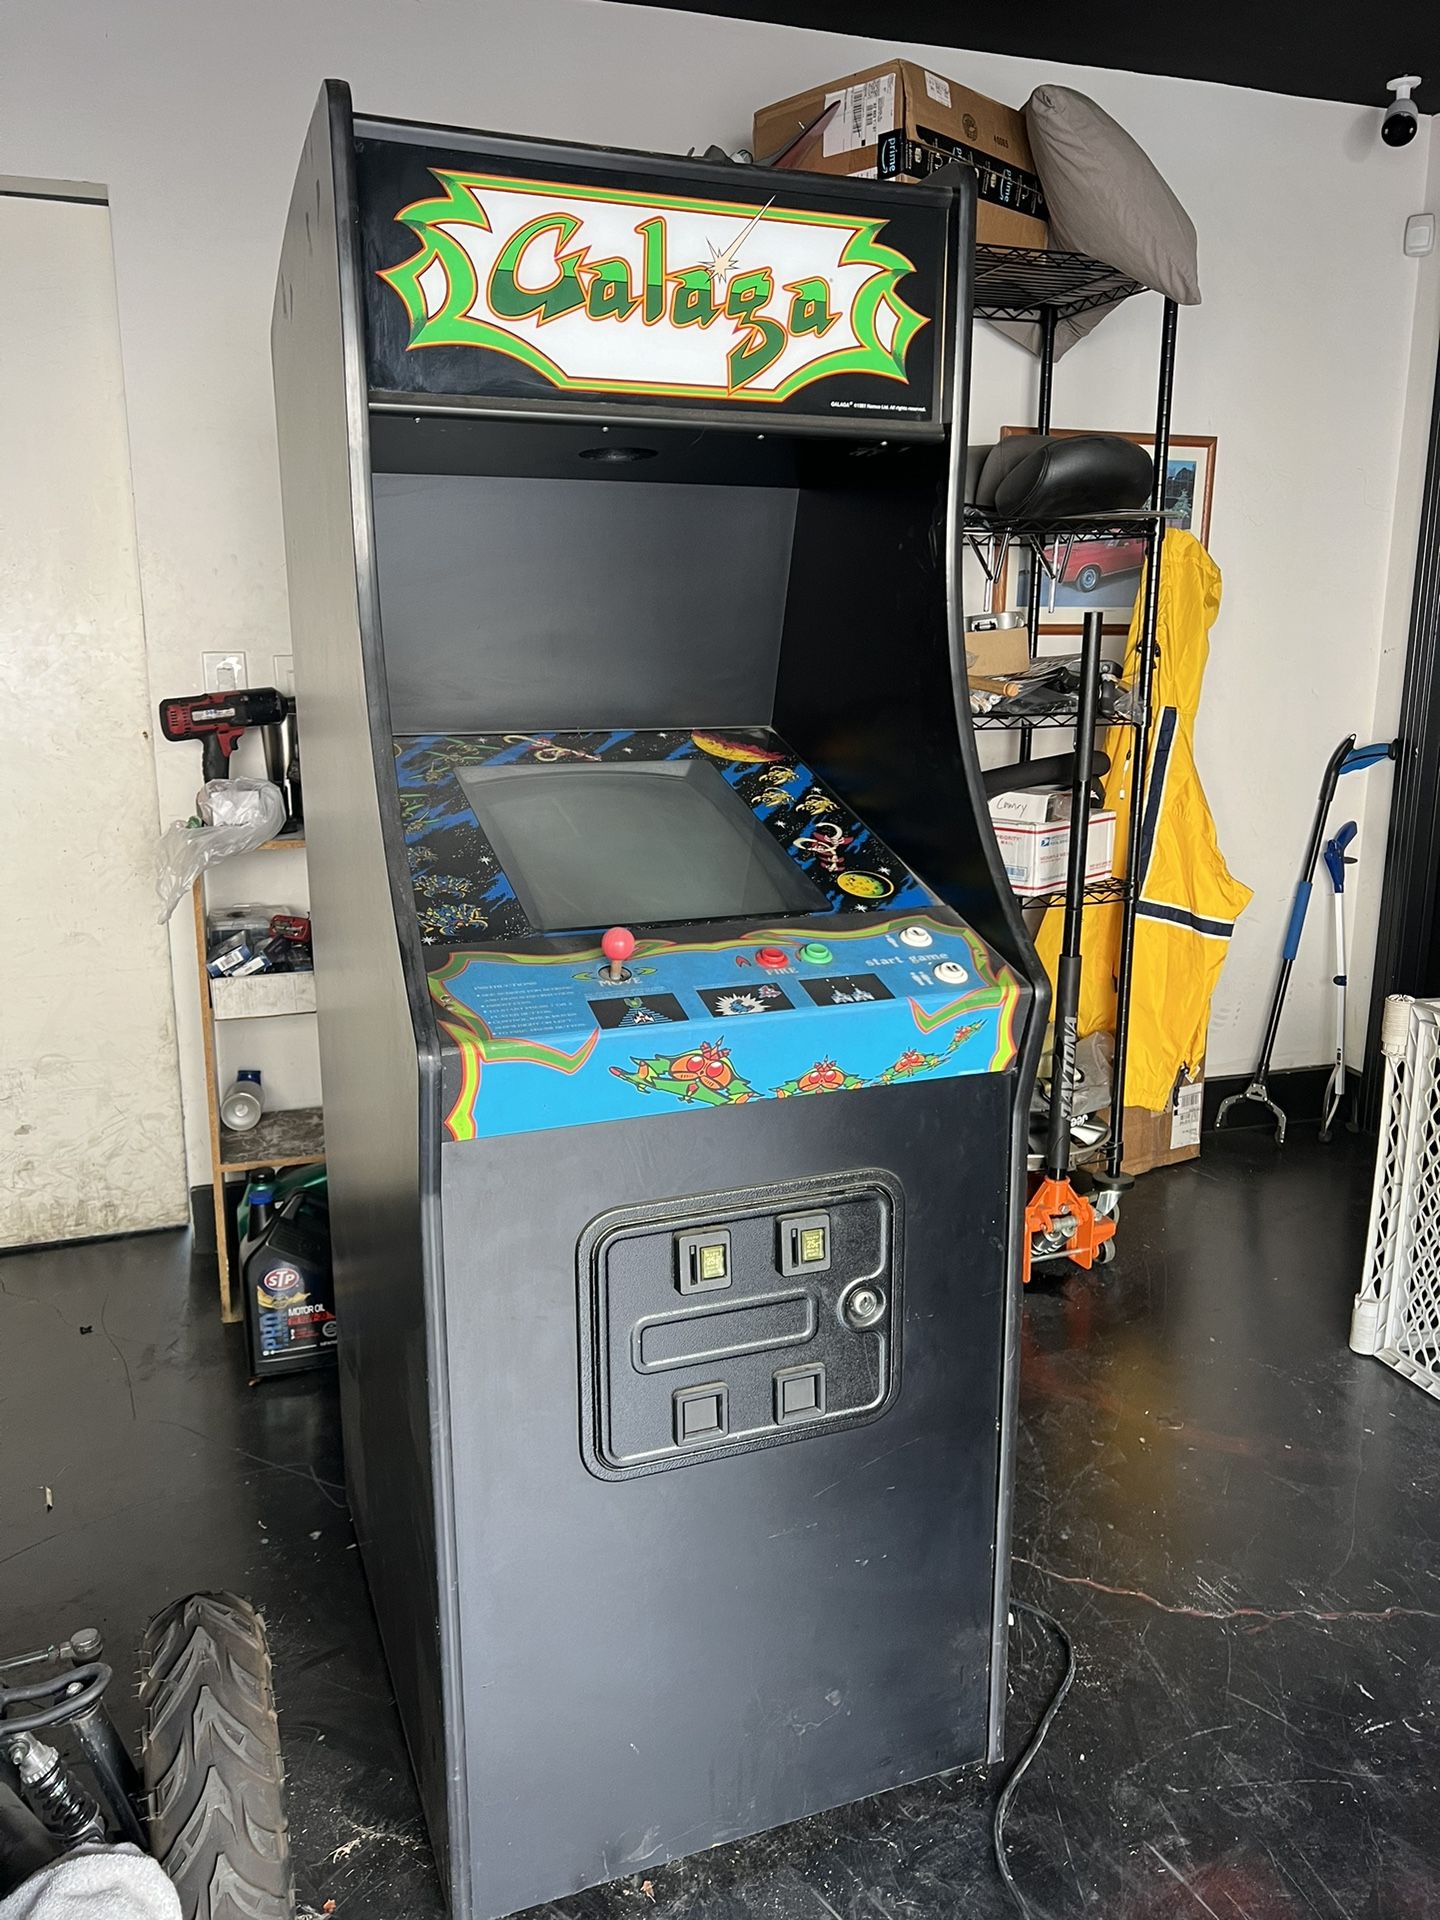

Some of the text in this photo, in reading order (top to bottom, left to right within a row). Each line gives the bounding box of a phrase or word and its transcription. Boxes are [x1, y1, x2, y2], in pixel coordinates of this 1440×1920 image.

[887, 137, 896, 172] prime
[487, 212, 842, 396] Galaga
[865, 952, 950, 966] start game
[765, 967, 800, 976] FIRE
[1060, 1015, 1077, 1119] DAYTONA
[267, 1270, 296, 1288] STP
[288, 1303, 326, 1317] MOTOR OIL
